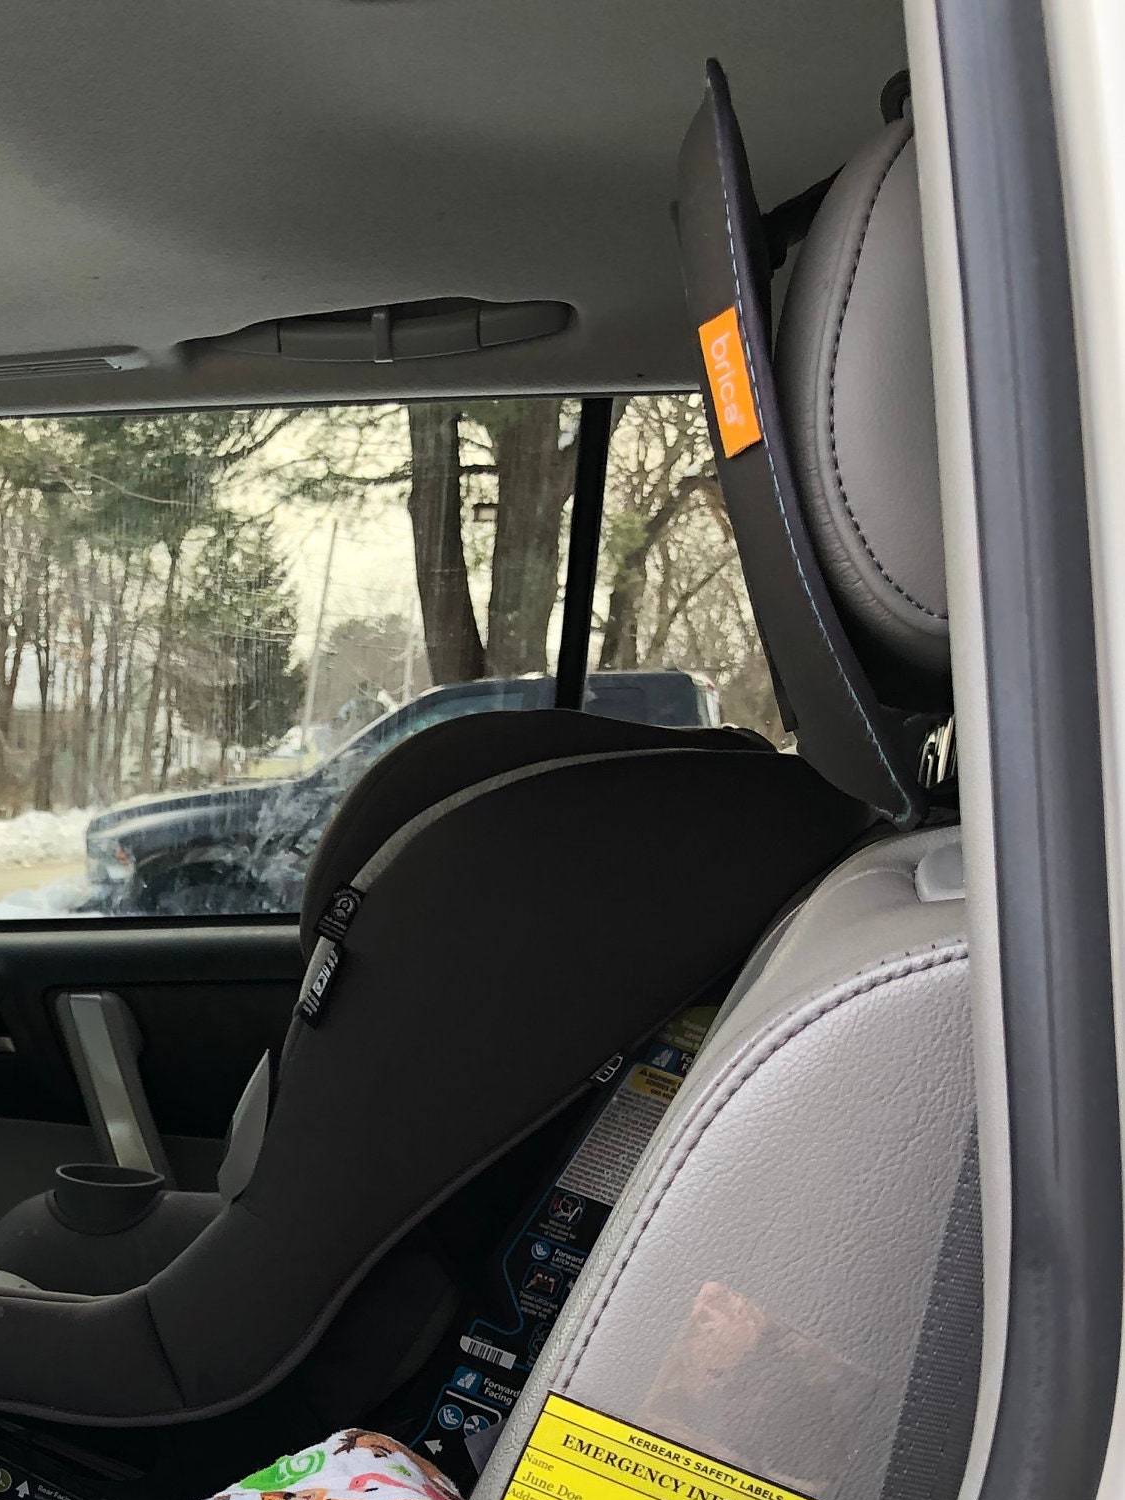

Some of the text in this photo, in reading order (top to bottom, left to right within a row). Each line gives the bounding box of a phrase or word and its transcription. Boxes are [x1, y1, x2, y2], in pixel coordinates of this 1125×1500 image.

[710, 331, 741, 427] brica
[483, 1377, 521, 1398] Forward
[484, 1387, 513, 1406] Facing
[522, 1451, 555, 1472] Name
[562, 1434, 686, 1494] EMERGENCY
[628, 1434, 692, 1467] KERBEAR'S
[693, 1461, 738, 1485] SAFETY
[522, 1471, 555, 1492] June
